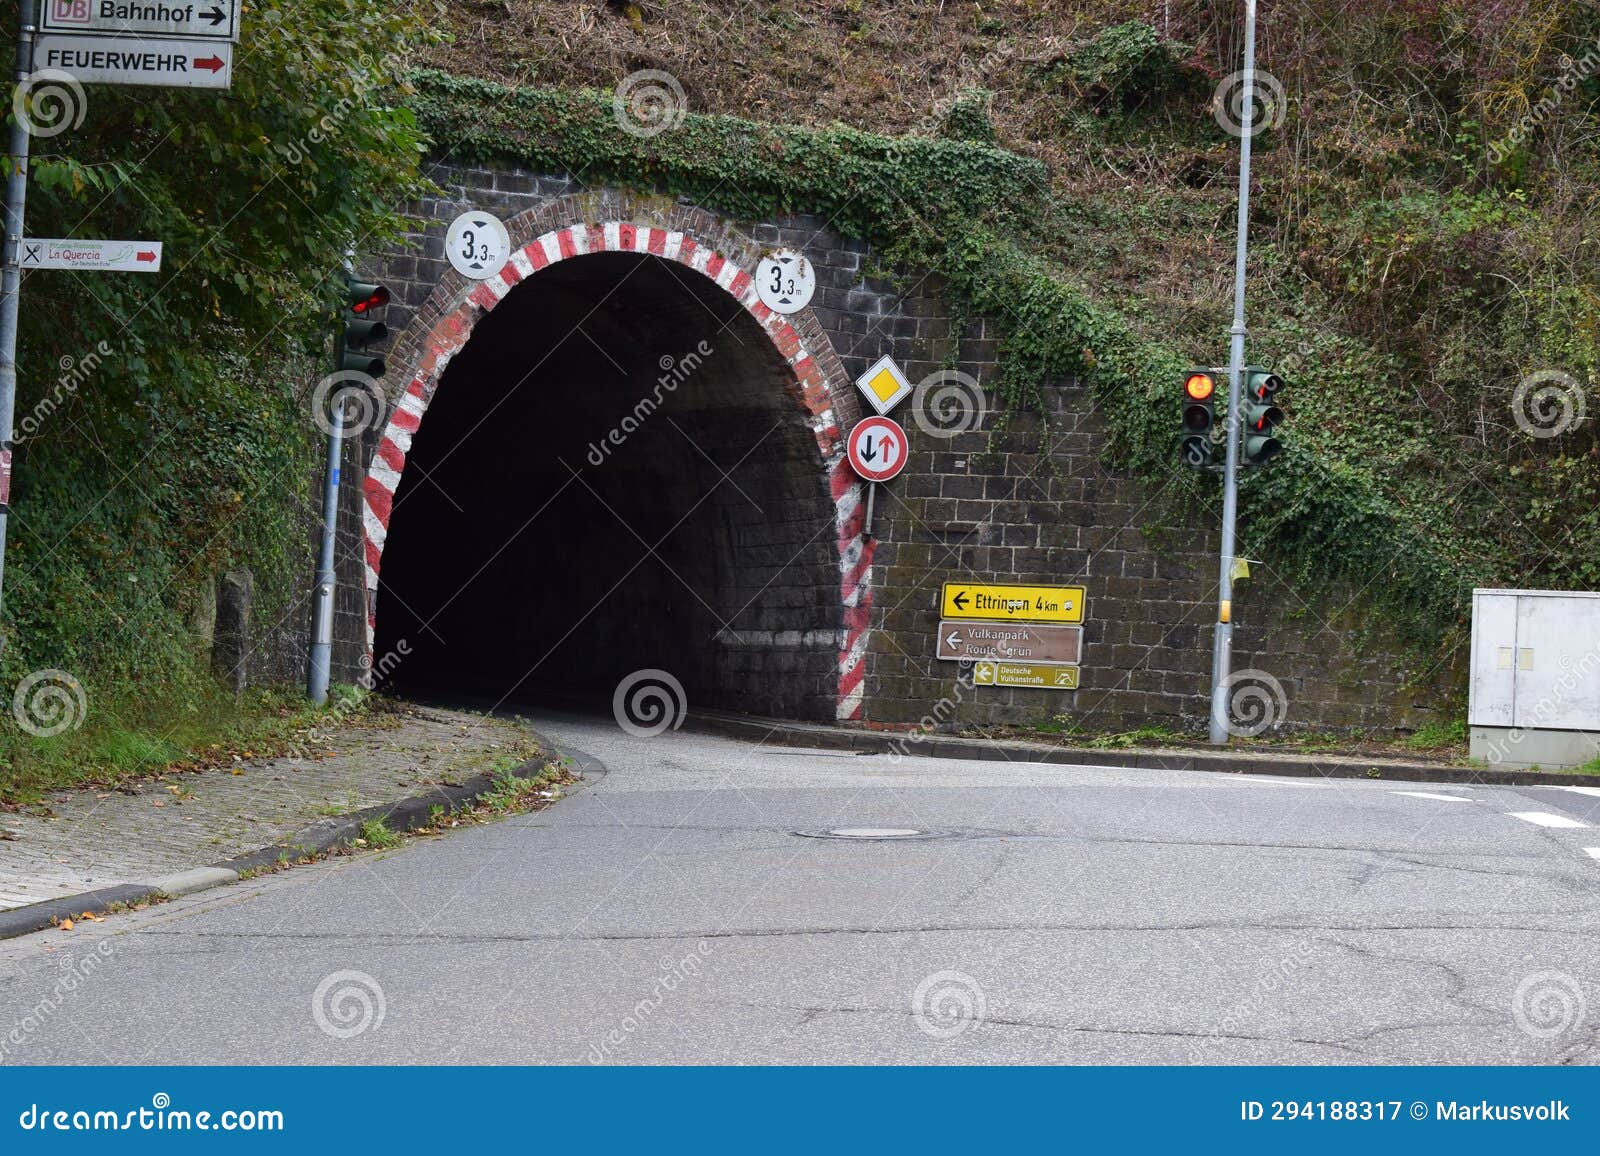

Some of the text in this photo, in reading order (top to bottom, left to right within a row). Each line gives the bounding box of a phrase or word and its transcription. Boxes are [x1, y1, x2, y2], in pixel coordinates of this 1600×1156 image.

[57, 0, 193, 23] DB Bahnhof
[47, 49, 188, 73] FEUERWEHR
[48, 249, 100, 261] La Quercia
[1036, 596, 1043, 611] 4
[1044, 600, 1058, 611] km
[968, 628, 1029, 641] Vulkanpark
[966, 643, 997, 656] Route
[1001, 666, 1032, 675] Deutsche
